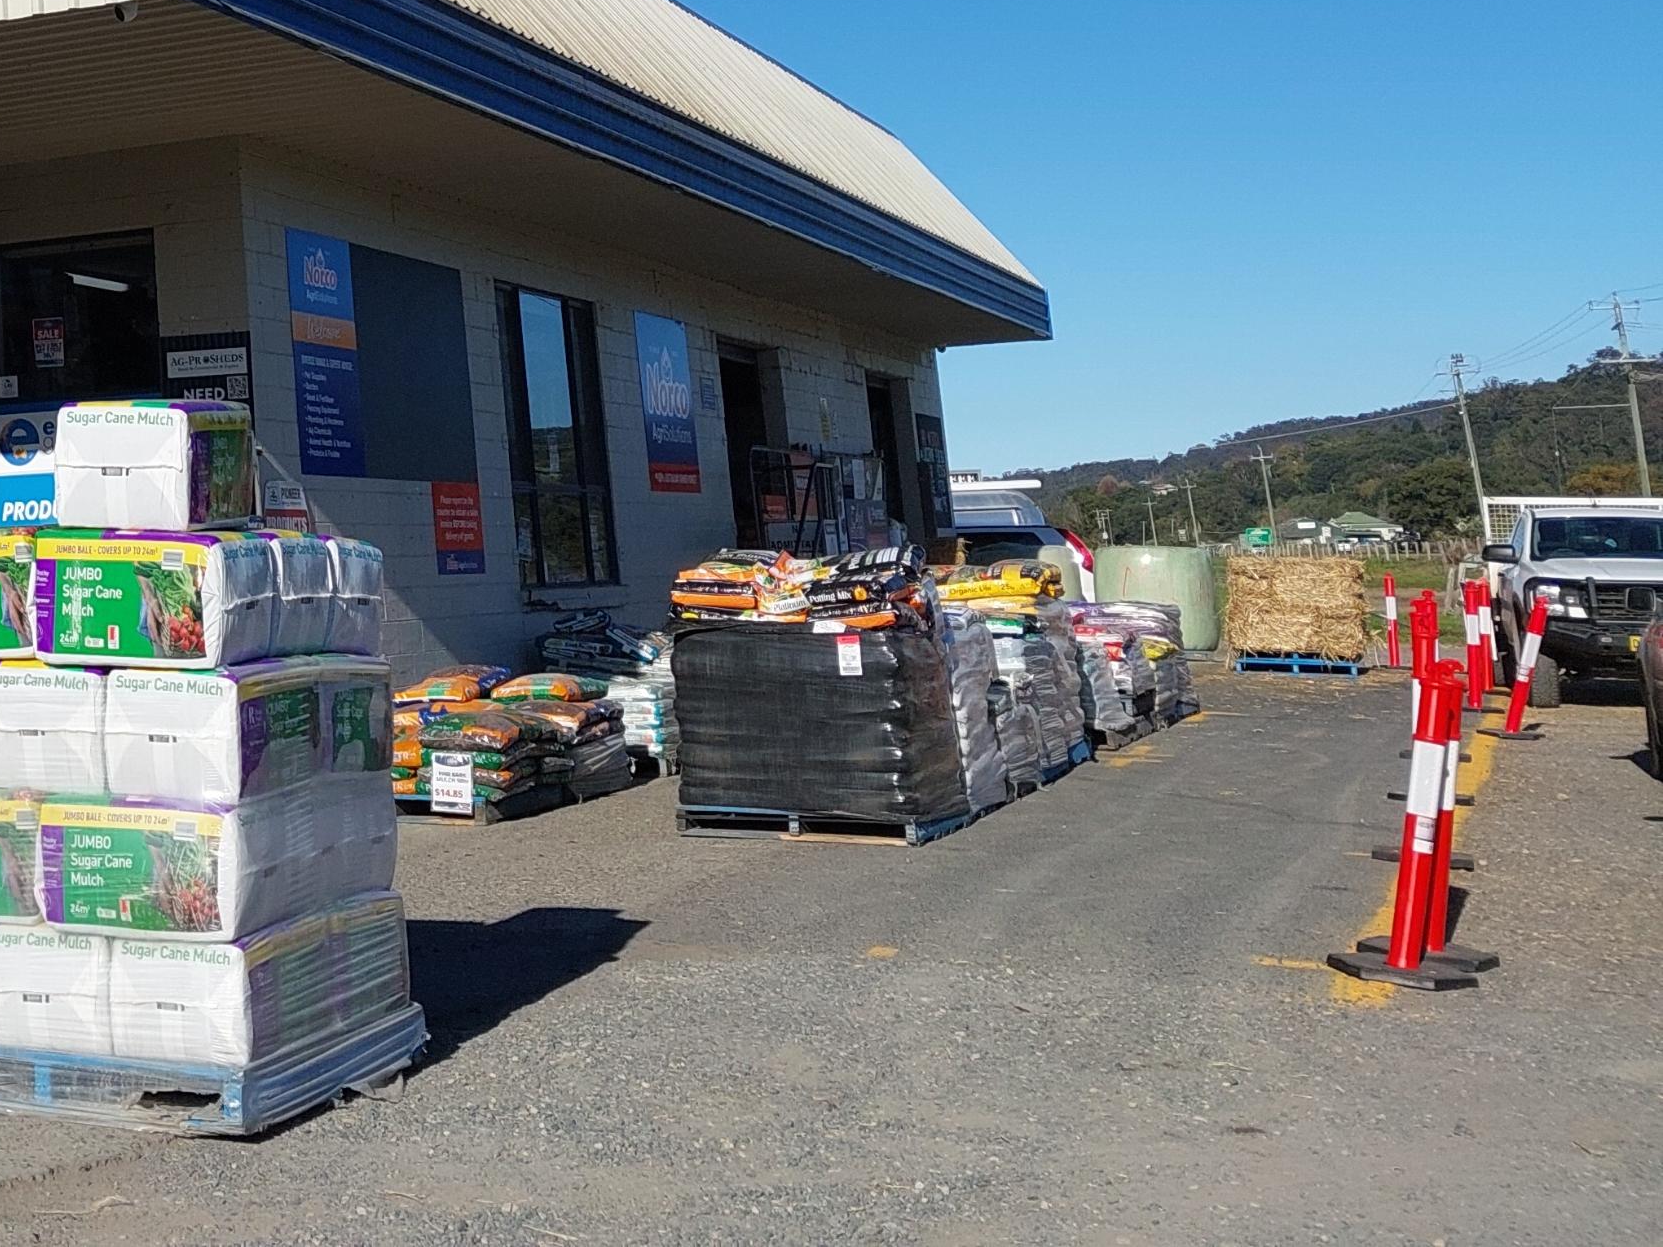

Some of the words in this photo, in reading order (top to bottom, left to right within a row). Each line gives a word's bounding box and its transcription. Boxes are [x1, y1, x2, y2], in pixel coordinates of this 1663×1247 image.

[303, 256, 337, 290] Norco
[38, 329, 59, 340] SALE
[646, 362, 689, 419] Norco
[66, 411, 100, 425] Sugar
[105, 411, 135, 424] Cane
[137, 411, 174, 426] Mulch
[55, 546, 76, 554] JUMBO
[98, 546, 122, 555] COVERS
[123, 546, 131, 555] UP
[134, 547, 142, 555] TO
[62, 567, 102, 581] JUMBO
[62, 585, 94, 599] Sugar
[95, 585, 123, 599] Cane
[809, 591, 836, 604] Potting
[837, 591, 852, 601] Mix
[949, 586, 978, 595] Organic
[773, 599, 808, 612] Platinum
[23, 674, 51, 688] Cane
[54, 676, 89, 691] Mulch
[115, 676, 152, 692] Sugar
[154, 678, 184, 693] Cane
[186, 681, 223, 696] Mulch
[435, 789, 463, 799] $14.85
[63, 811, 85, 820] JUMBO
[86, 812, 101, 821] BALE
[107, 814, 132, 823] COVERS
[134, 815, 143, 824] UP
[145, 816, 153, 824] TO
[70, 835, 111, 849] JUMBO
[70, 854, 103, 870] Sugar
[104, 854, 133, 868] Cane
[70, 872, 104, 886] Mulch
[26, 932, 55, 947] Cane
[57, 935, 92, 951] Mulch
[121, 942, 158, 958] Sugar
[160, 945, 190, 961] Cane
[193, 947, 231, 966] Mulch
